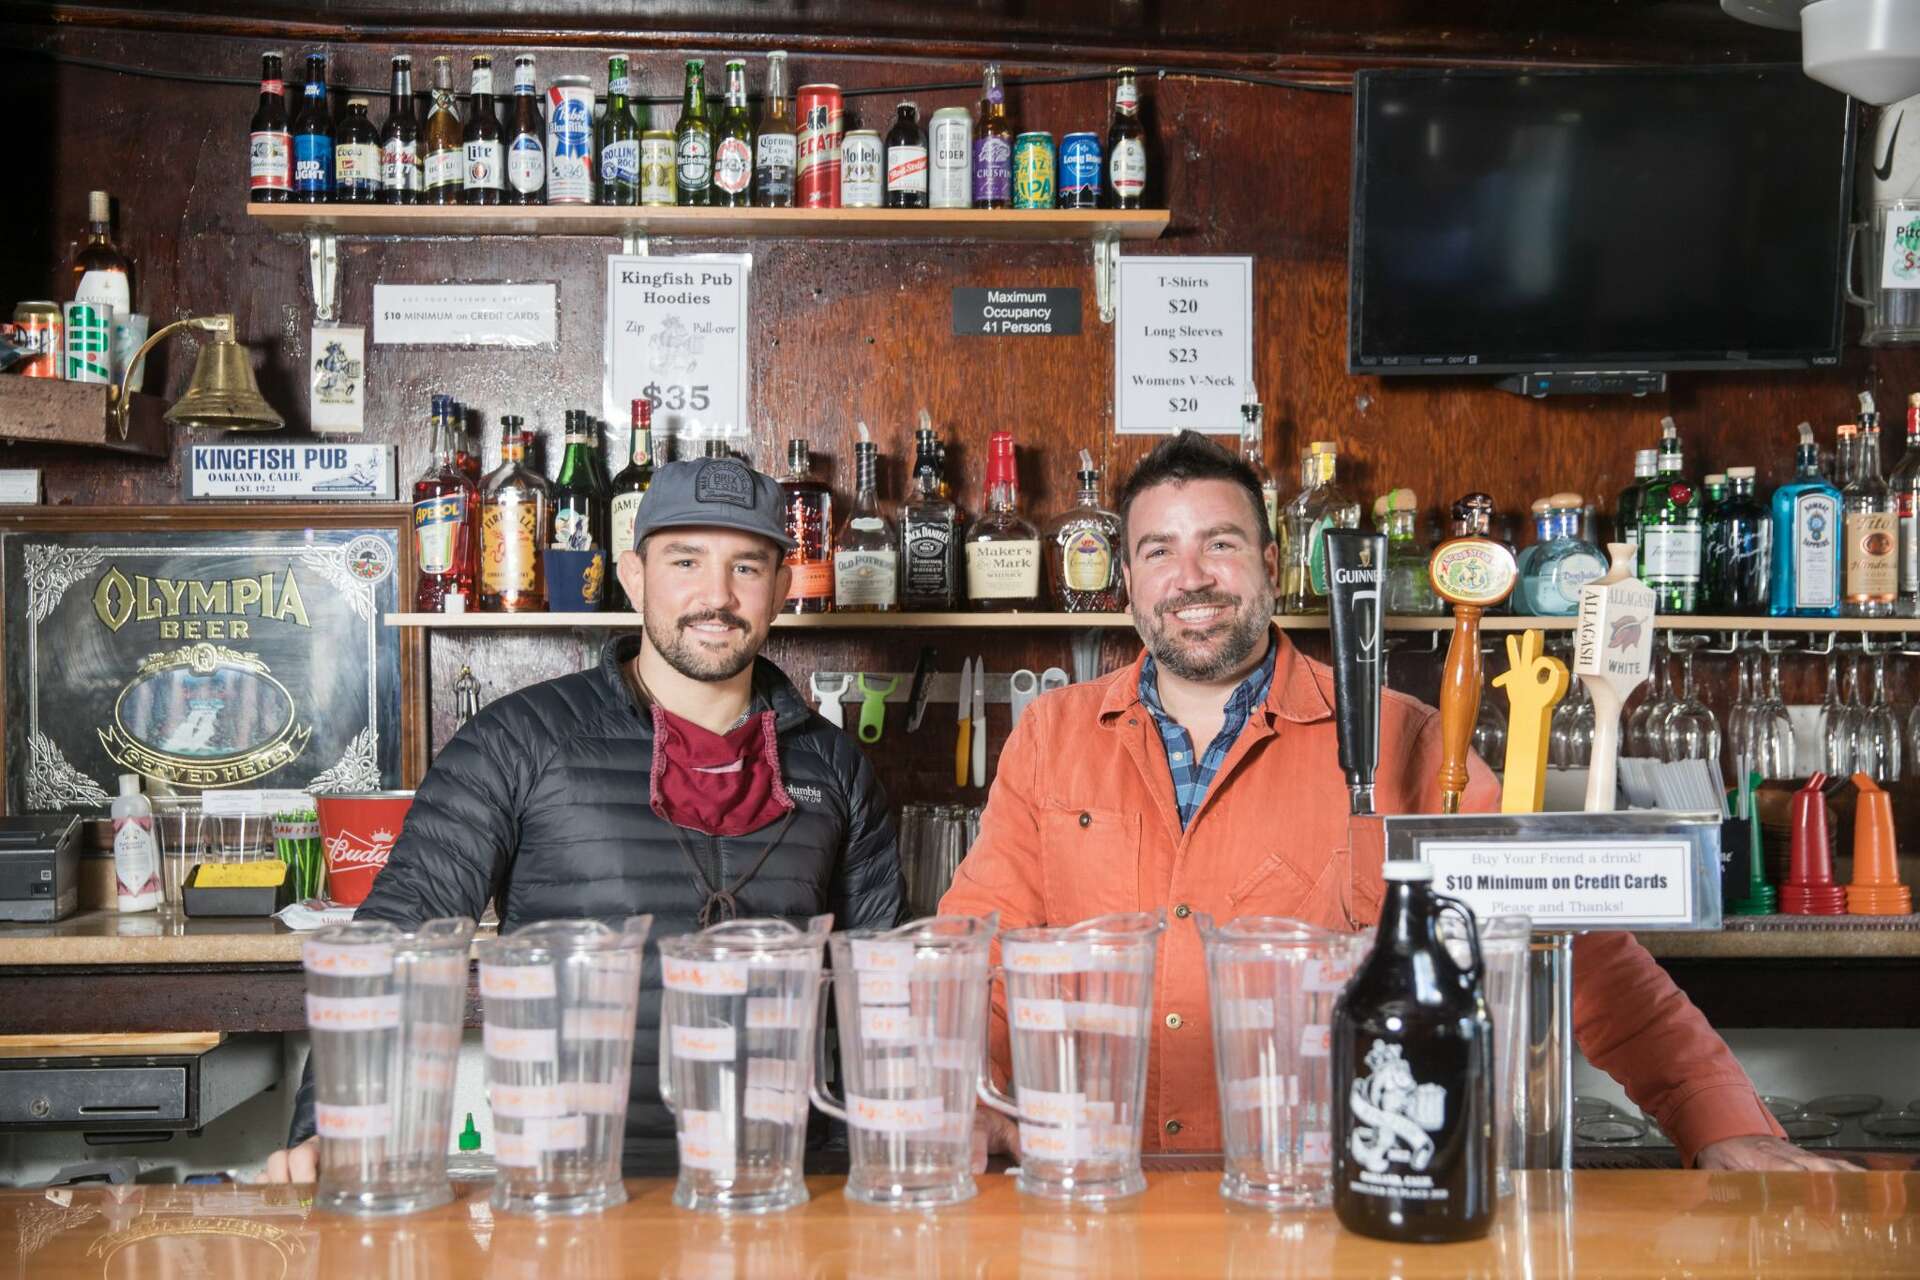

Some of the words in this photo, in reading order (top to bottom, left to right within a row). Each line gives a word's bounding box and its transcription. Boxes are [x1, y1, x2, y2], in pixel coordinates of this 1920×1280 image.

[467, 145, 492, 161] Lite
[297, 161, 320, 170] BUD
[295, 170, 325, 180] LIGHT
[621, 271, 694, 288] Kingfish
[701, 273, 733, 286] Pub
[1158, 276, 1209, 288] T-Shirts
[643, 292, 711, 305] Hoodies
[987, 290, 1047, 303] Maximum
[982, 306, 1052, 321] Occupancy
[1168, 298, 1199, 315] $20
[384, 311, 401, 321] $10
[404, 312, 453, 321] MINIMUM
[470, 312, 503, 321] CREDIT
[506, 312, 540, 321] CARDS
[625, 320, 646, 336] Zip
[982, 321, 999, 333] 41
[1001, 321, 1052, 333] Persons
[1143, 326, 1176, 339] Long
[1179, 326, 1224, 338] Sleeves
[1168, 347, 1199, 364] $23
[1132, 374, 1185, 387] Womens
[1189, 374, 1236, 387] V-Neck
[642, 380, 711, 415] $35
[1168, 397, 1199, 413] $20
[194, 448, 295, 471] KINGFISH
[304, 448, 348, 470] PUB
[614, 498, 640, 514] JAME
[415, 503, 460, 525] APEROL
[976, 546, 1032, 556] Maker's
[993, 558, 1032, 568] Mark
[92, 563, 312, 633] OLYMPIA
[160, 620, 251, 640] BEER
[1607, 659, 1641, 674] WHITE
[123, 748, 218, 783] SERVED
[222, 748, 288, 782] HERE
[785, 783, 821, 797] olumbia
[1472, 852, 1500, 866] Buy
[1504, 852, 1536, 865] Your
[1540, 852, 1585, 865] Friend
[1588, 856, 1598, 865] a
[1600, 852, 1643, 865] drink!
[1445, 874, 1473, 892] $10
[1476, 874, 1548, 891] Minimum
[1551, 877, 1571, 891] on
[1573, 874, 1621, 890] Credit
[1623, 873, 1669, 890] Cards
[1491, 901, 1536, 914] Please
[1538, 901, 1565, 914] and
[1568, 900, 1625, 914] Thanks!
